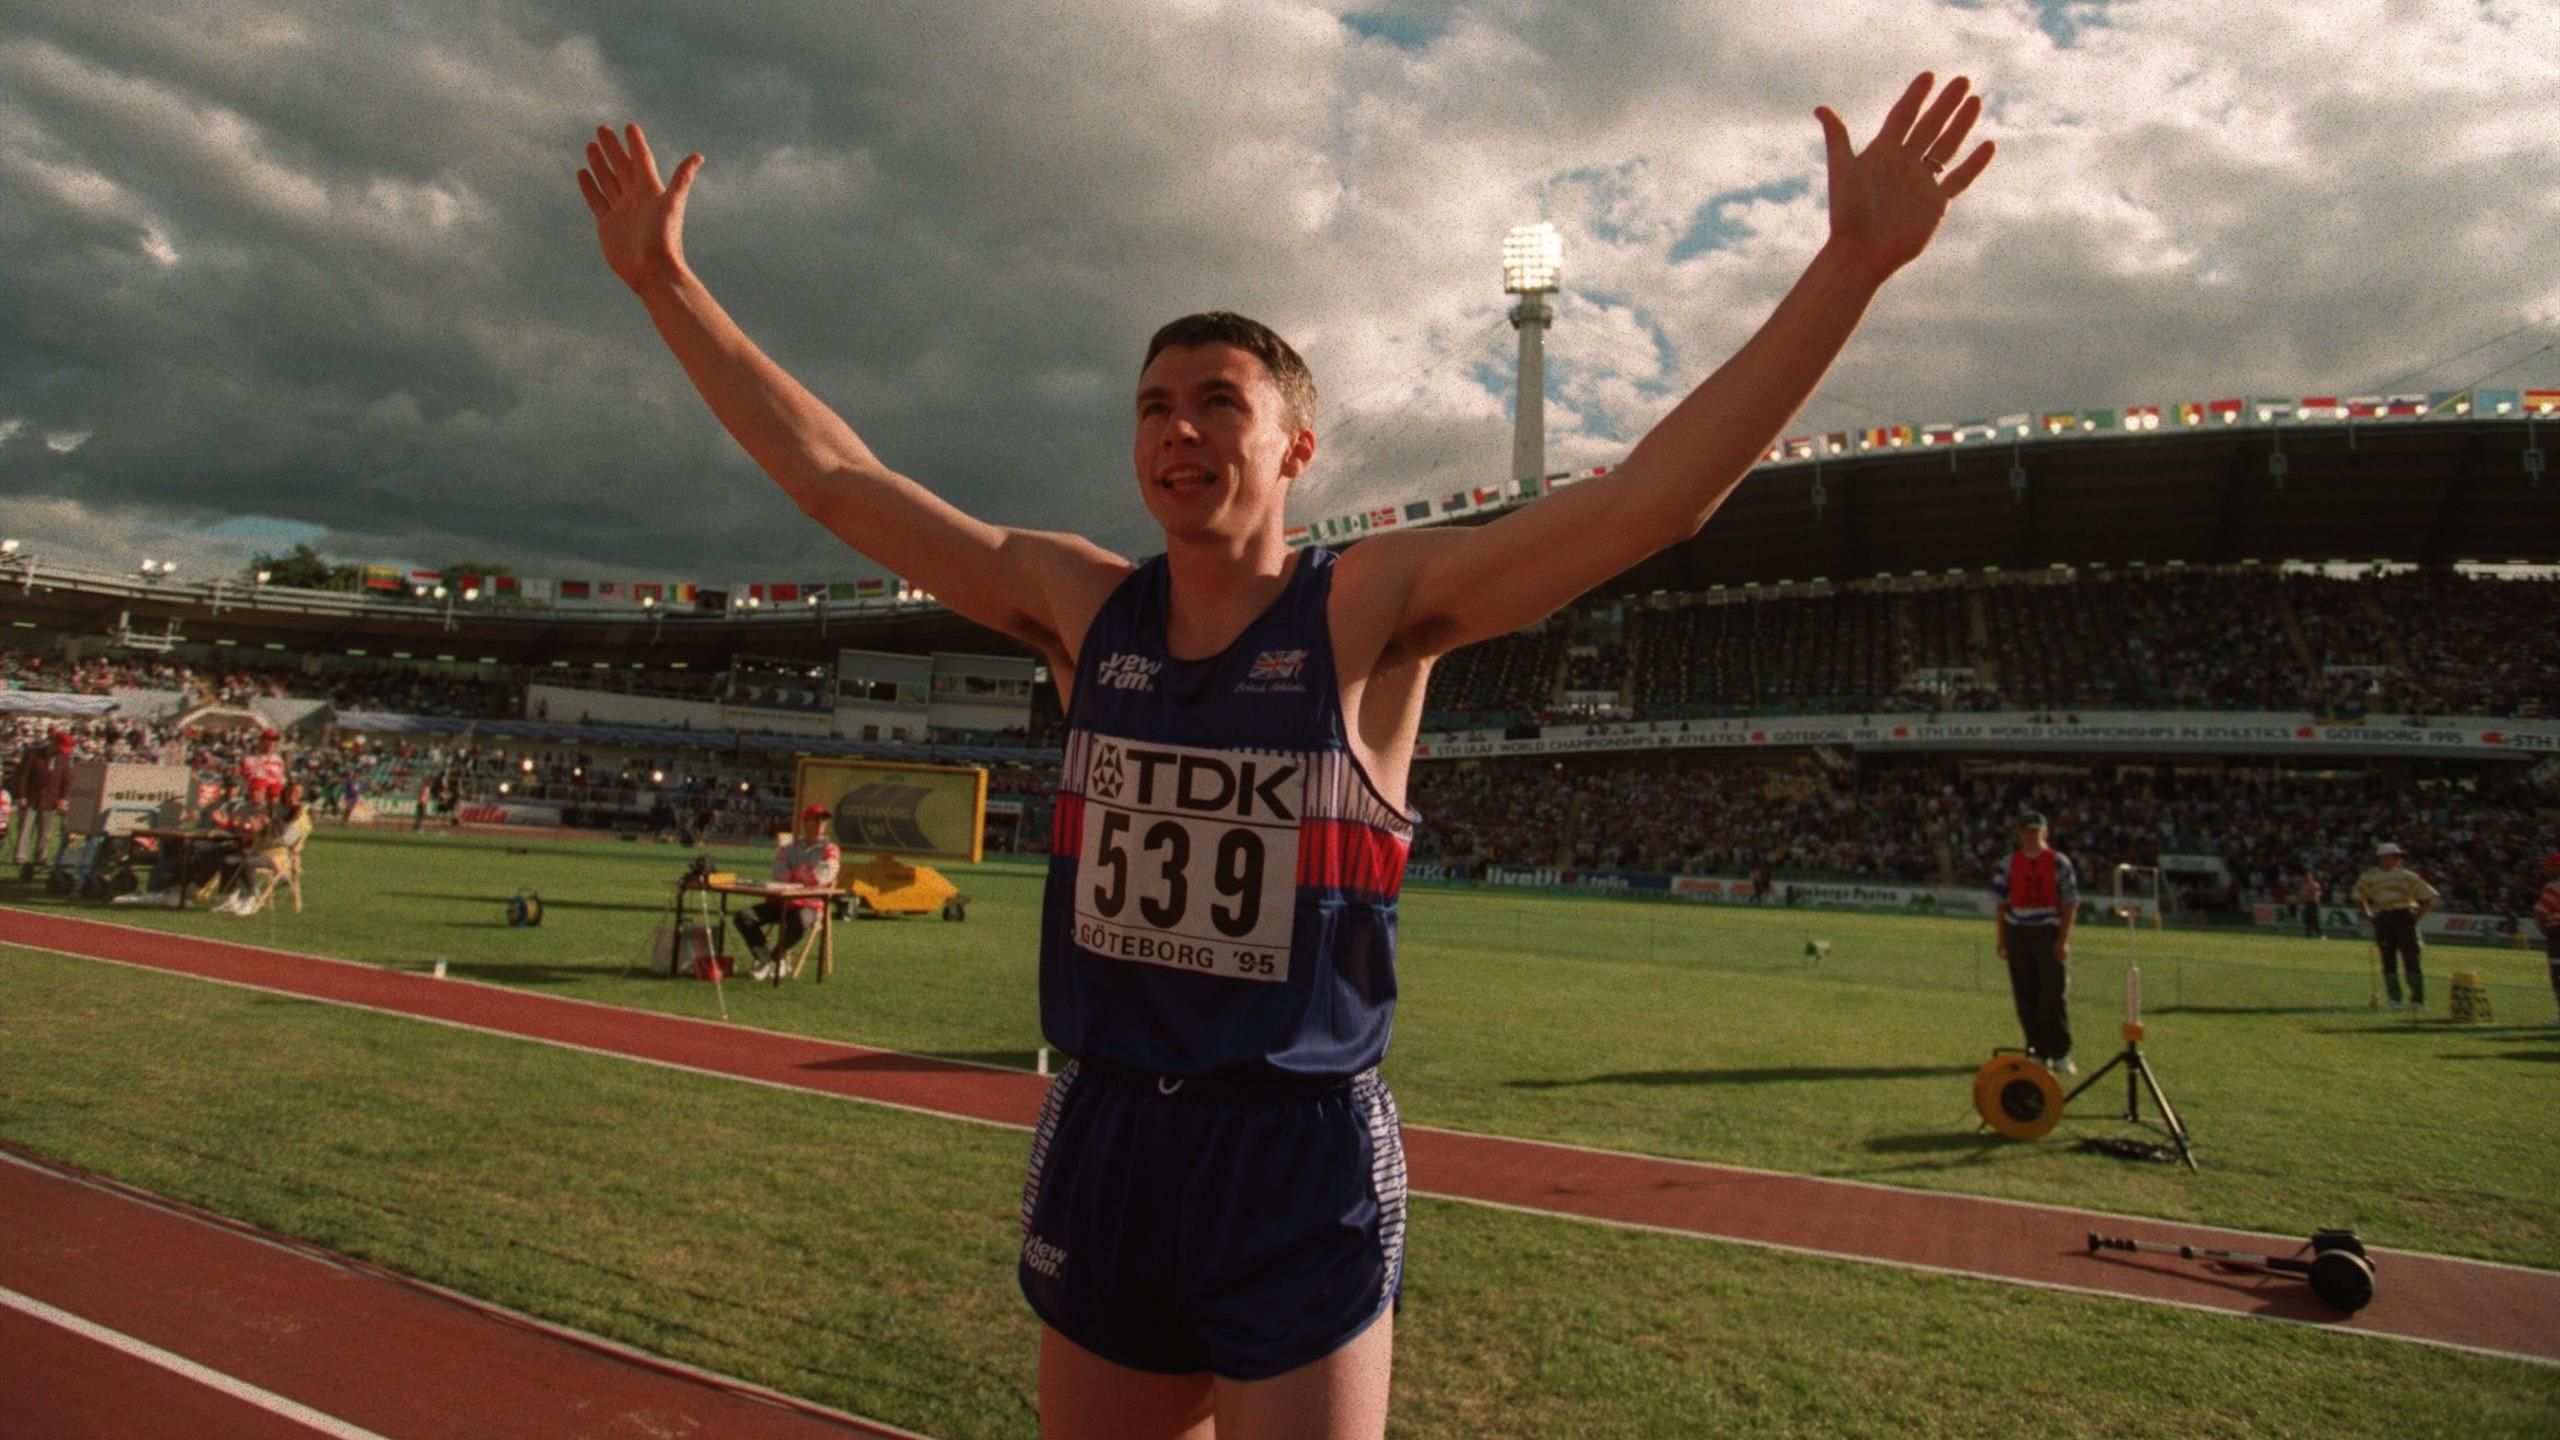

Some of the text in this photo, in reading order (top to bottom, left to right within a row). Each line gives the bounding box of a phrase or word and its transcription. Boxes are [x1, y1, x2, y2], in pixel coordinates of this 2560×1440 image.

[1499, 740, 1545, 754] WORLD
[1548, 736, 1651, 752] CHAMPIONSHIPS
[1678, 731, 1747, 745] ATHLETICS
[1991, 726, 2044, 737] WORLD
[2048, 726, 2174, 738] CHAMPIONSHIPS
[2203, 727, 2289, 739] ATHLETICS
[1126, 750, 1296, 821] TDK
[1094, 810, 1266, 938] 539
[1405, 864, 1456, 880] EIKO
[1487, 866, 1562, 887] livetti
[1080, 923, 1275, 975] GÖTEBORG '95
